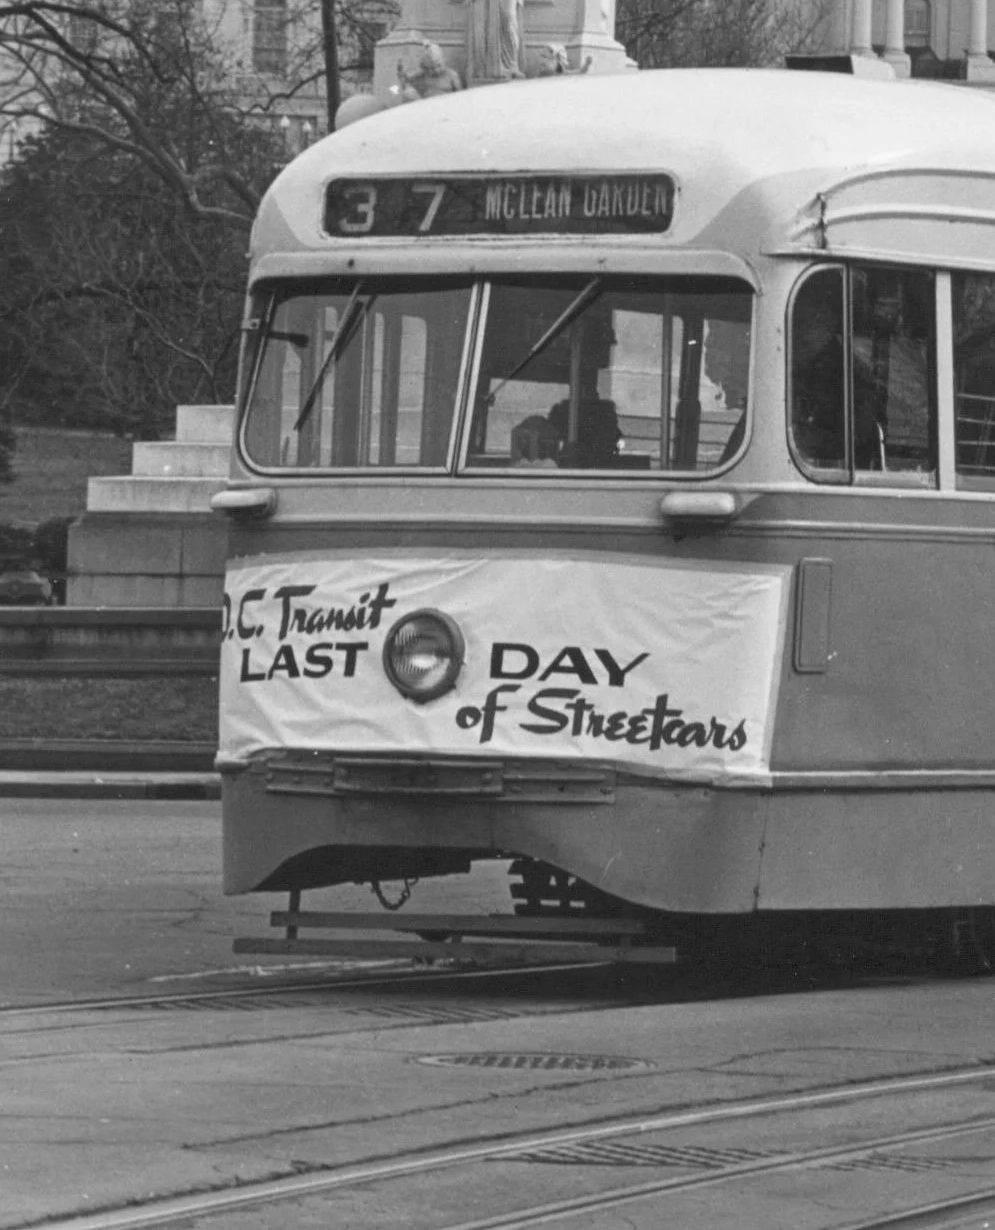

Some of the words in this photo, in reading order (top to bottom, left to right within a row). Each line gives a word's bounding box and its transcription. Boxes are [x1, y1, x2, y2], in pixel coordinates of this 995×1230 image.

[274, 583, 396, 641] Transit
[240, 642, 368, 682] LAST
[489, 642, 651, 687] DAY
[455, 685, 521, 744] of
[520, 688, 748, 751] Streetcars
